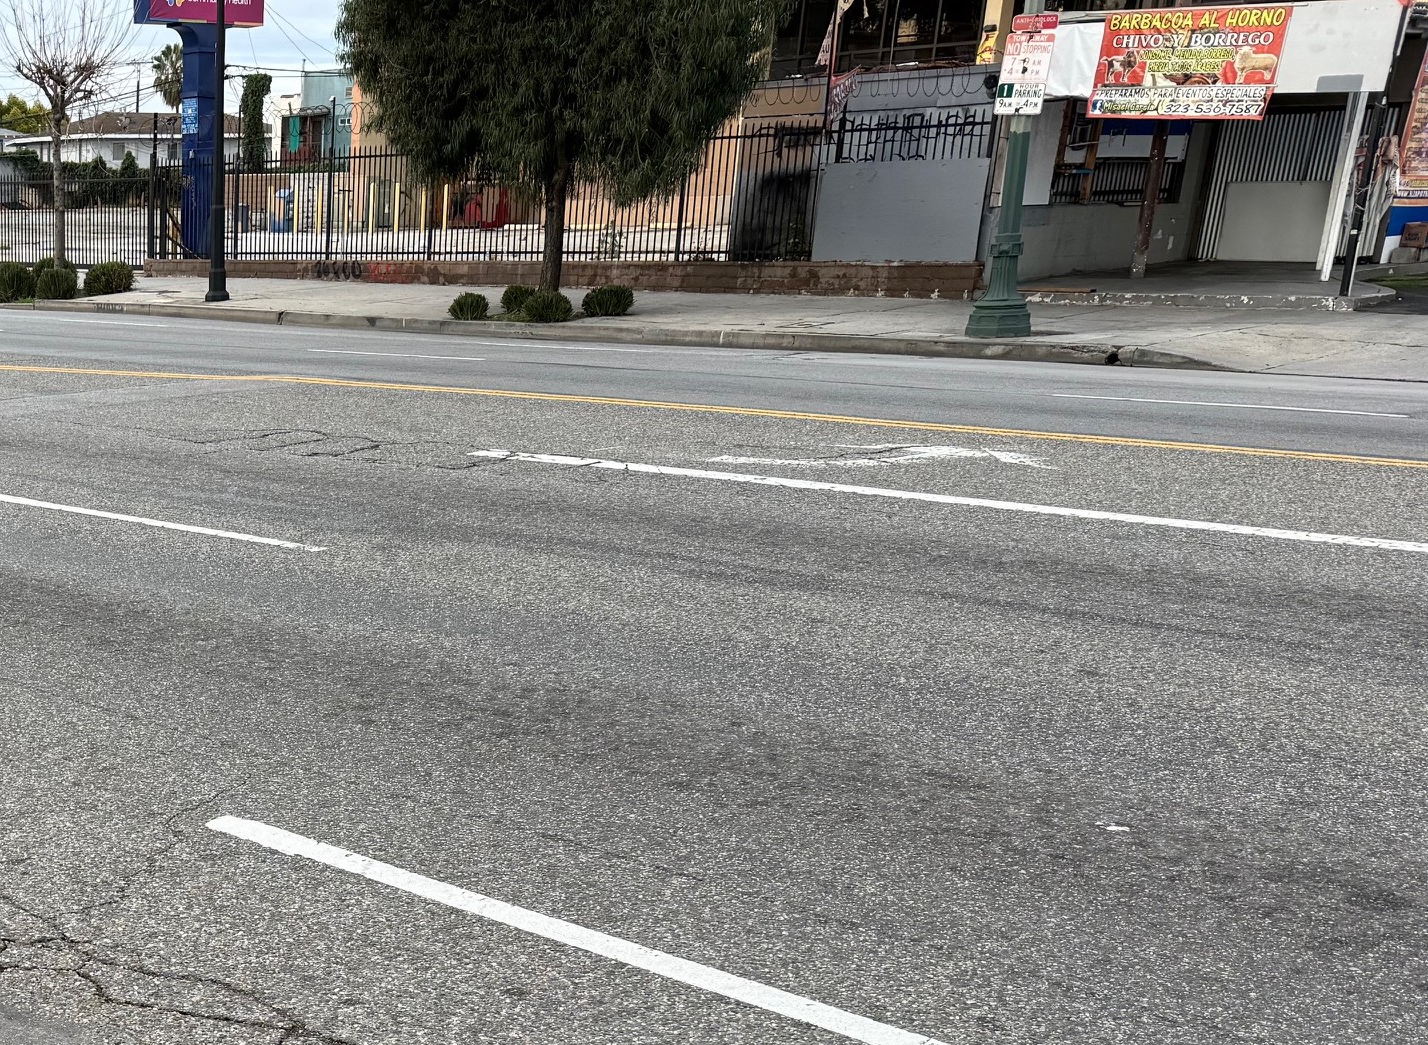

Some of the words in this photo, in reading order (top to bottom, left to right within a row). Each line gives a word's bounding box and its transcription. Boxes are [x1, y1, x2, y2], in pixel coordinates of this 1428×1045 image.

[1110, 11, 1193, 31] BARBACOA
[1198, 10, 1220, 29] AL
[1225, 8, 1286, 27] HORNO
[1113, 34, 1164, 48] CHIVO
[1172, 33, 1185, 47] Y
[1191, 32, 1274, 47] BORREGO
[1006, 42, 1021, 55] NO
[1022, 44, 1051, 54] STOPPING
[1003, 84, 1009, 97] 1
[1014, 89, 1042, 98] PARKING
[1153, 88, 1175, 99] PARA
[1176, 88, 1214, 98] EVENTOS
[1215, 87, 1264, 98] ESPECIALES
